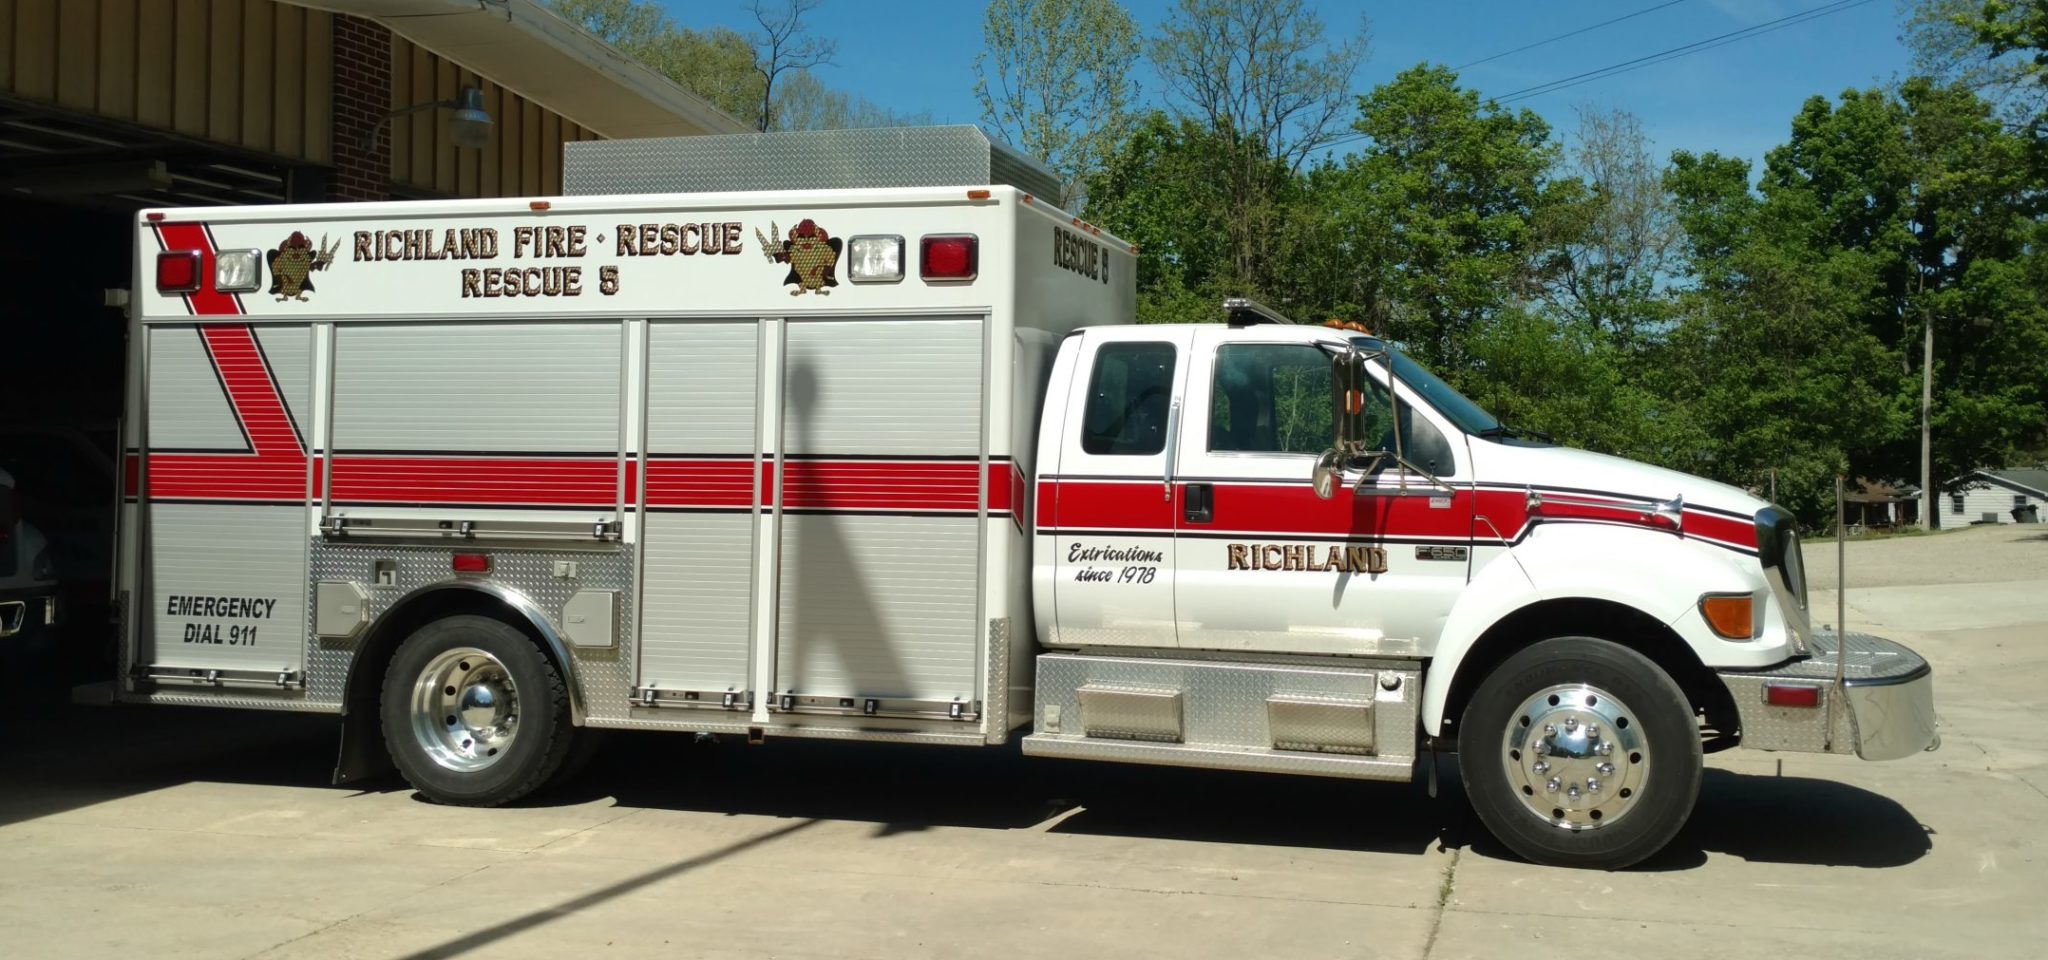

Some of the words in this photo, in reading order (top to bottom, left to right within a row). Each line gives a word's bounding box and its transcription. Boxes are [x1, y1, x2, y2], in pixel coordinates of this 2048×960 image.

[353, 228, 499, 262] RICHLAND
[513, 225, 588, 259] FIRE
[616, 222, 743, 257] RESCUE
[1053, 225, 1098, 281] RESCUE
[1101, 247, 1109, 285] 5
[461, 266, 583, 298] RESCUE
[599, 265, 620, 296] 5
[1067, 542, 1163, 563] Extrications
[1227, 543, 1388, 573] RICHLAND
[1074, 566, 1113, 582] since
[1117, 566, 1157, 584] 1978
[167, 595, 277, 619] EMERGENCY
[183, 623, 223, 645] DIAL
[229, 625, 257, 646] 911
